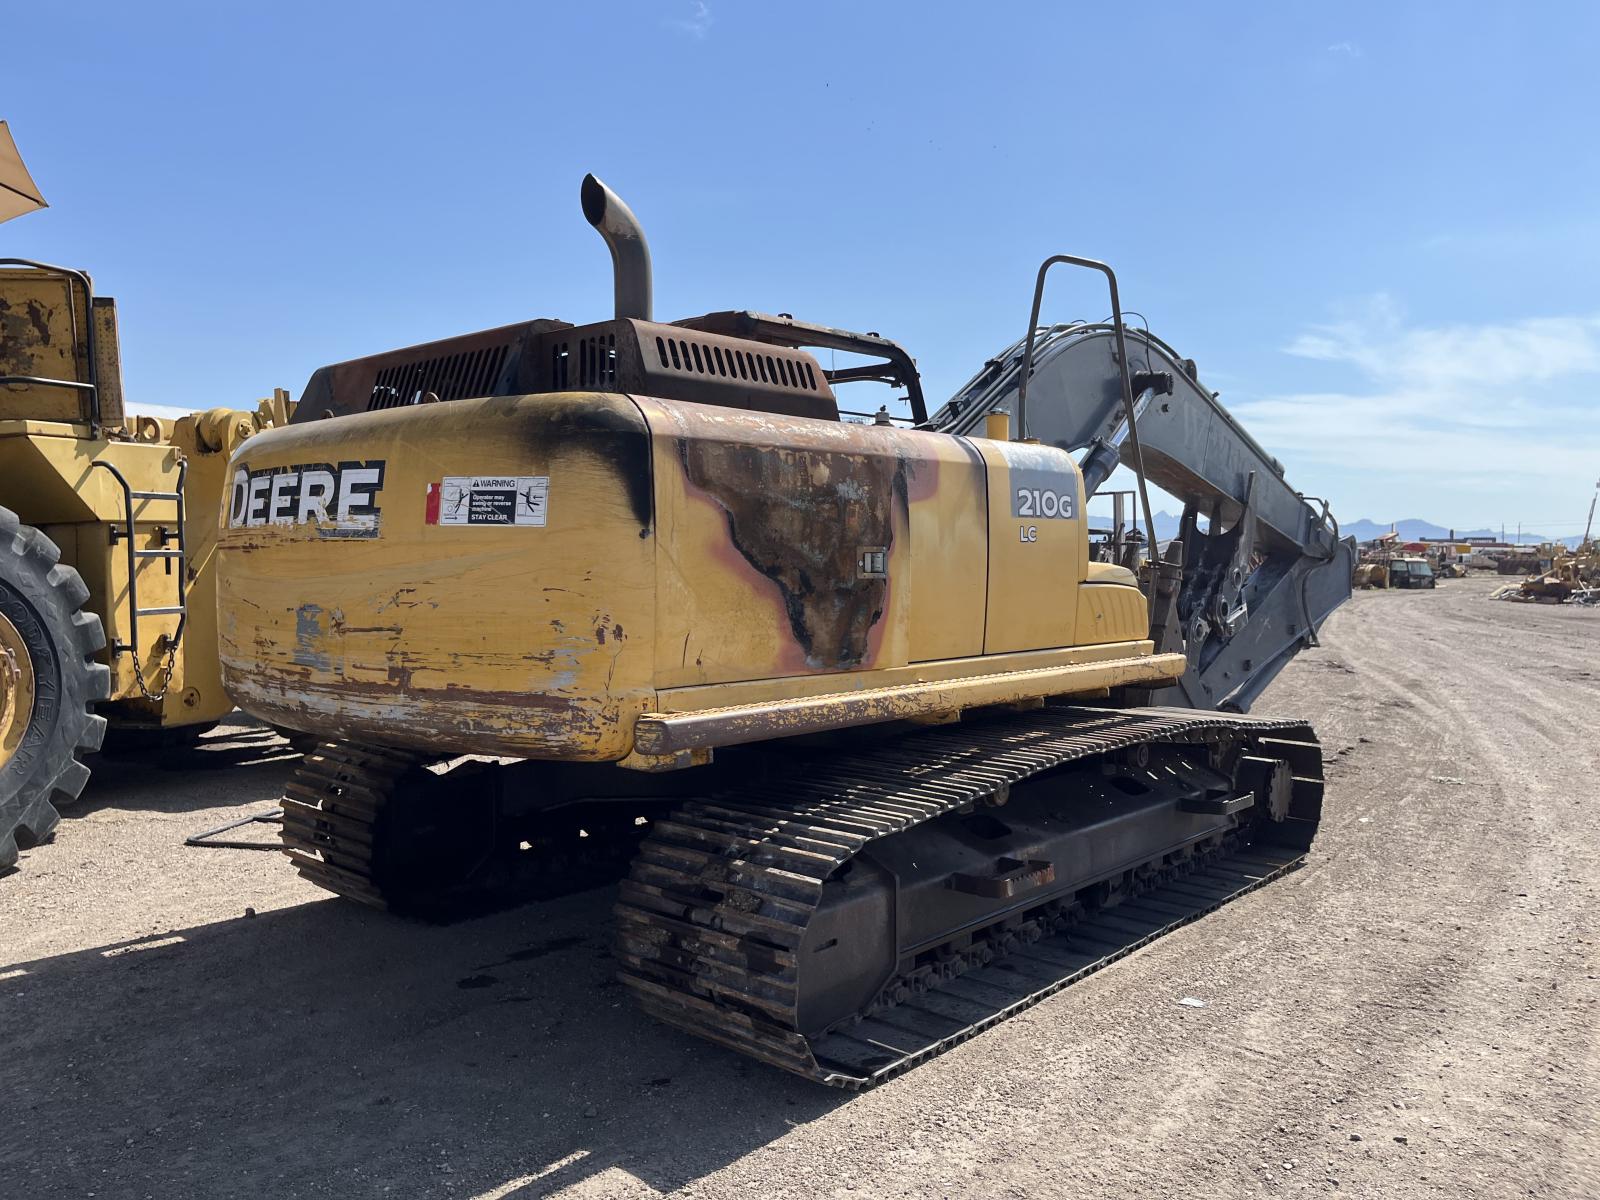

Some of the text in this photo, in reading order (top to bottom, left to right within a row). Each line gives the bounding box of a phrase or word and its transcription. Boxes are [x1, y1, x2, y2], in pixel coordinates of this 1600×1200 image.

[480, 480, 515, 488] WARNING
[230, 465, 381, 531] DEERE
[1018, 489, 1072, 518] 210G
[1020, 526, 1037, 542] LC
